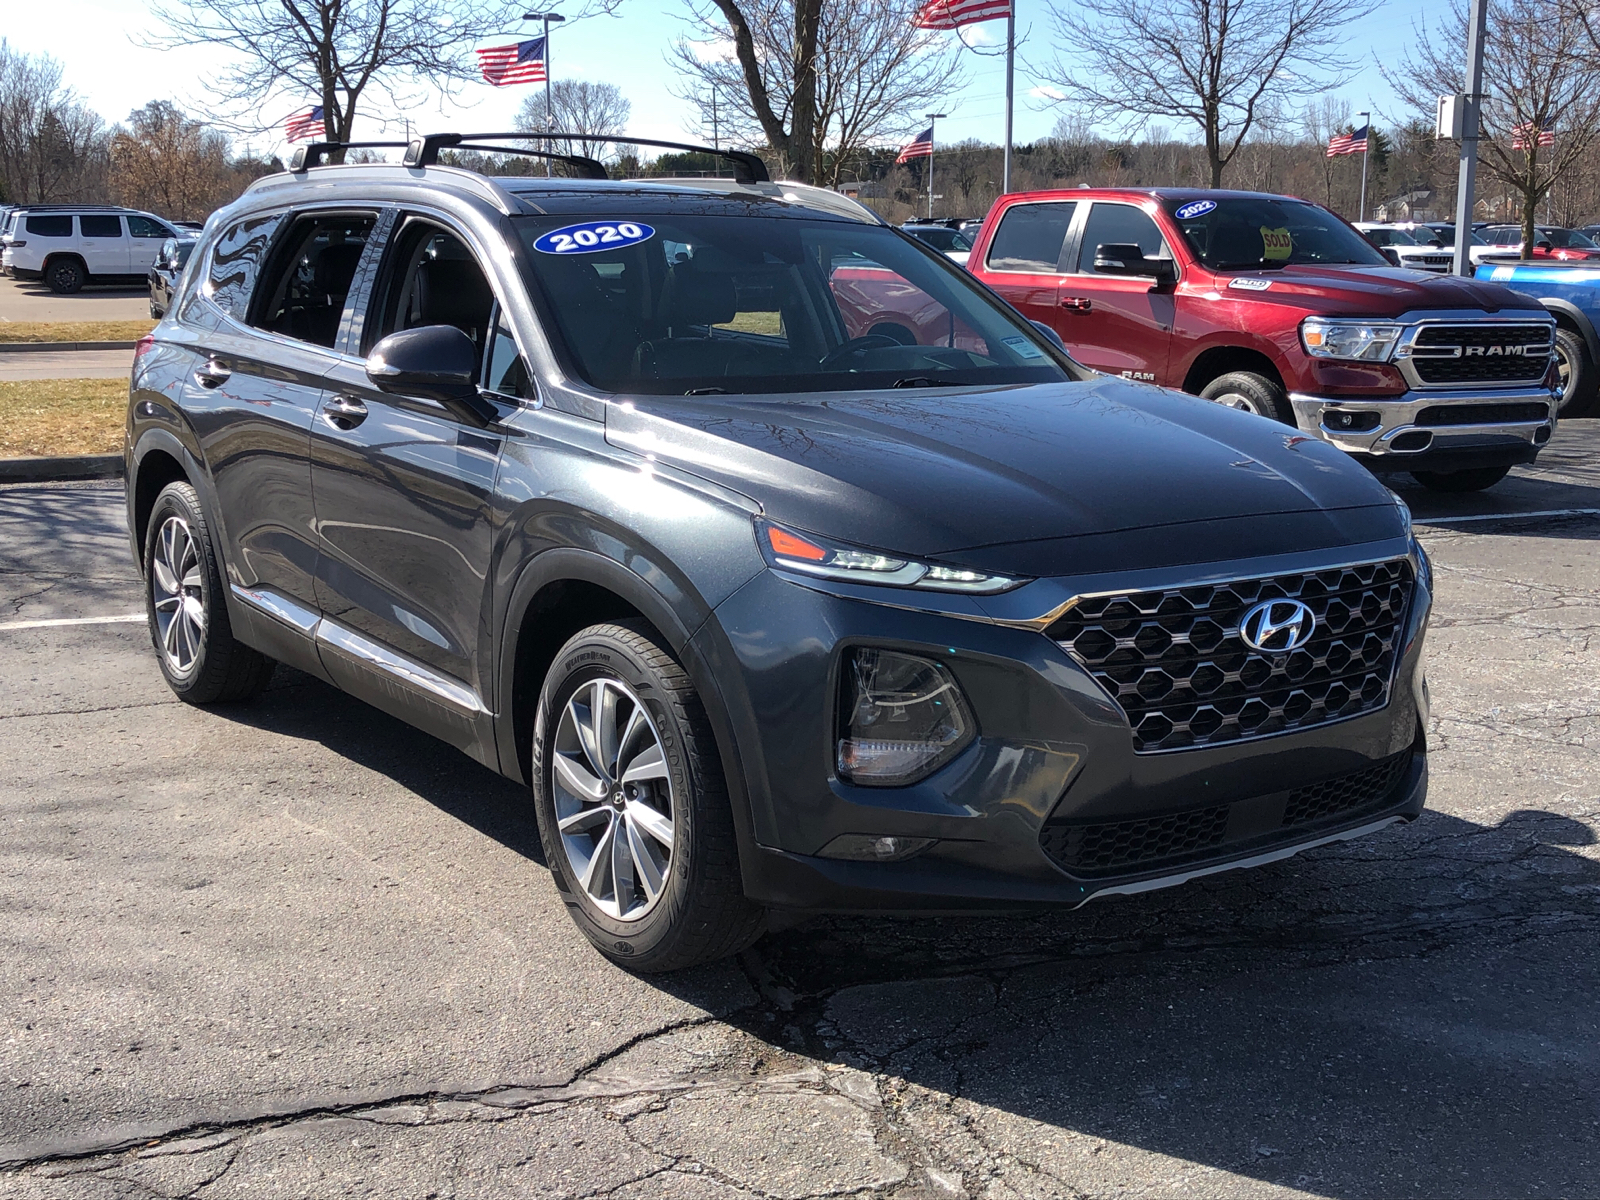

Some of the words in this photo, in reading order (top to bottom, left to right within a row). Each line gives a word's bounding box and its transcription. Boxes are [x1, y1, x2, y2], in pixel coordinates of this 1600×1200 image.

[1180, 201, 1214, 218] 2022
[549, 223, 643, 252] 2020
[1263, 233, 1290, 248] SOLD
[1465, 345, 1523, 357] RAM
[1121, 370, 1155, 381] RAM
